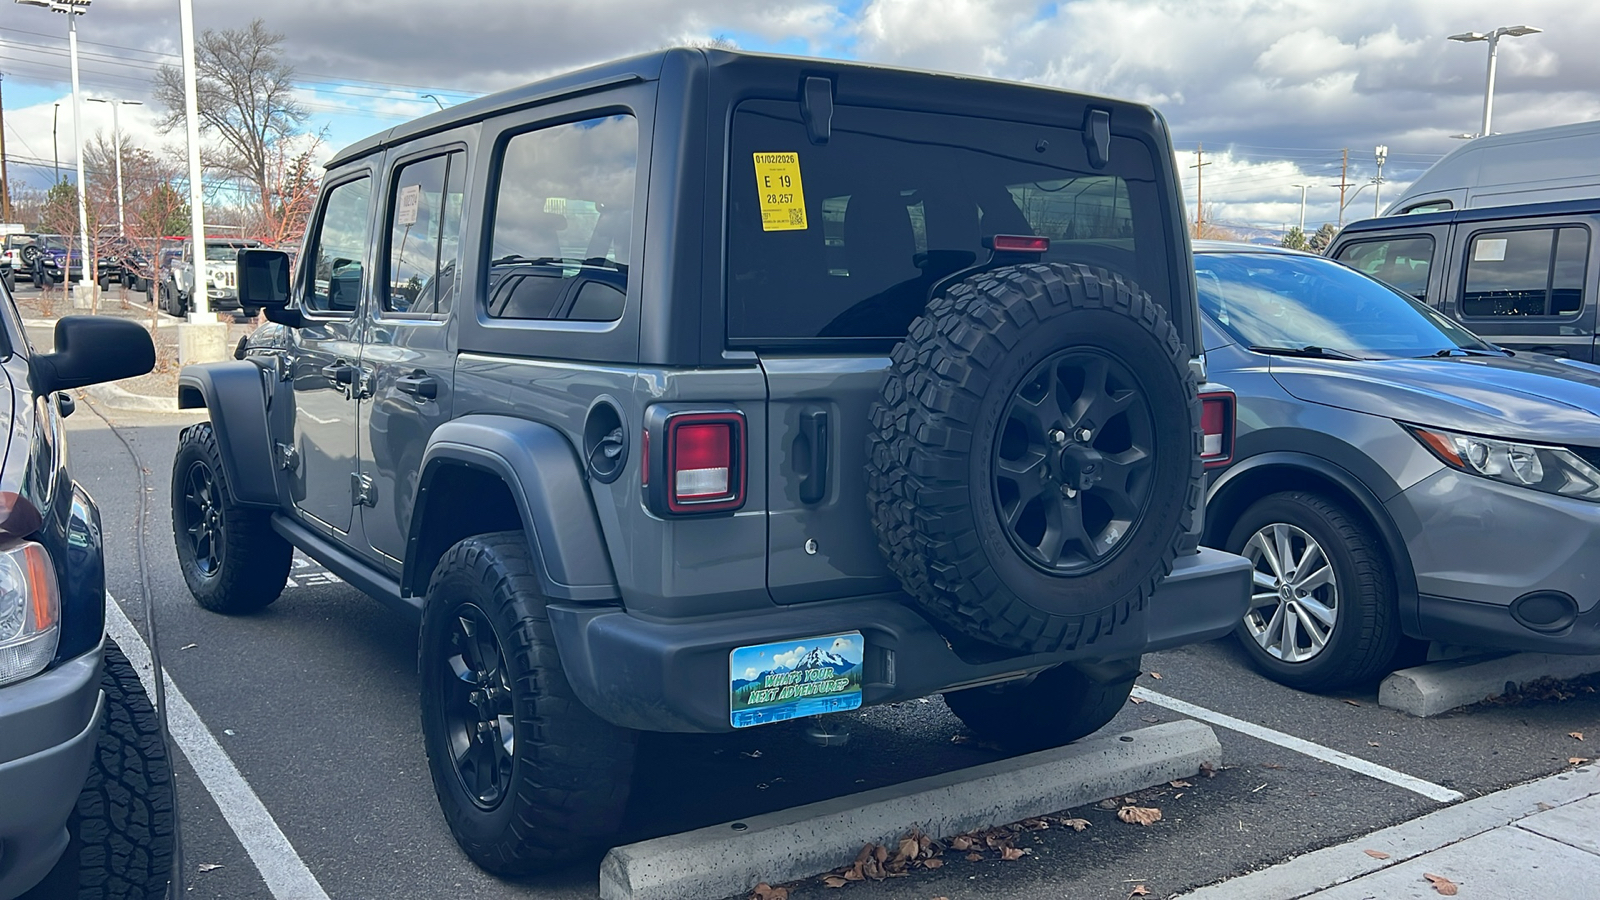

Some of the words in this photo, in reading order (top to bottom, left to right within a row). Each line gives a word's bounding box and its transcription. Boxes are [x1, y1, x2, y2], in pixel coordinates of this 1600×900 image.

[756, 155, 795, 164] 01/02/2026
[764, 175, 771, 188] E
[779, 175, 791, 188] 19
[767, 194, 793, 205] 28,257
[804, 667, 834, 682] YOUR
[747, 688, 780, 705] NEXT
[778, 678, 850, 700] ADVENTURE?
